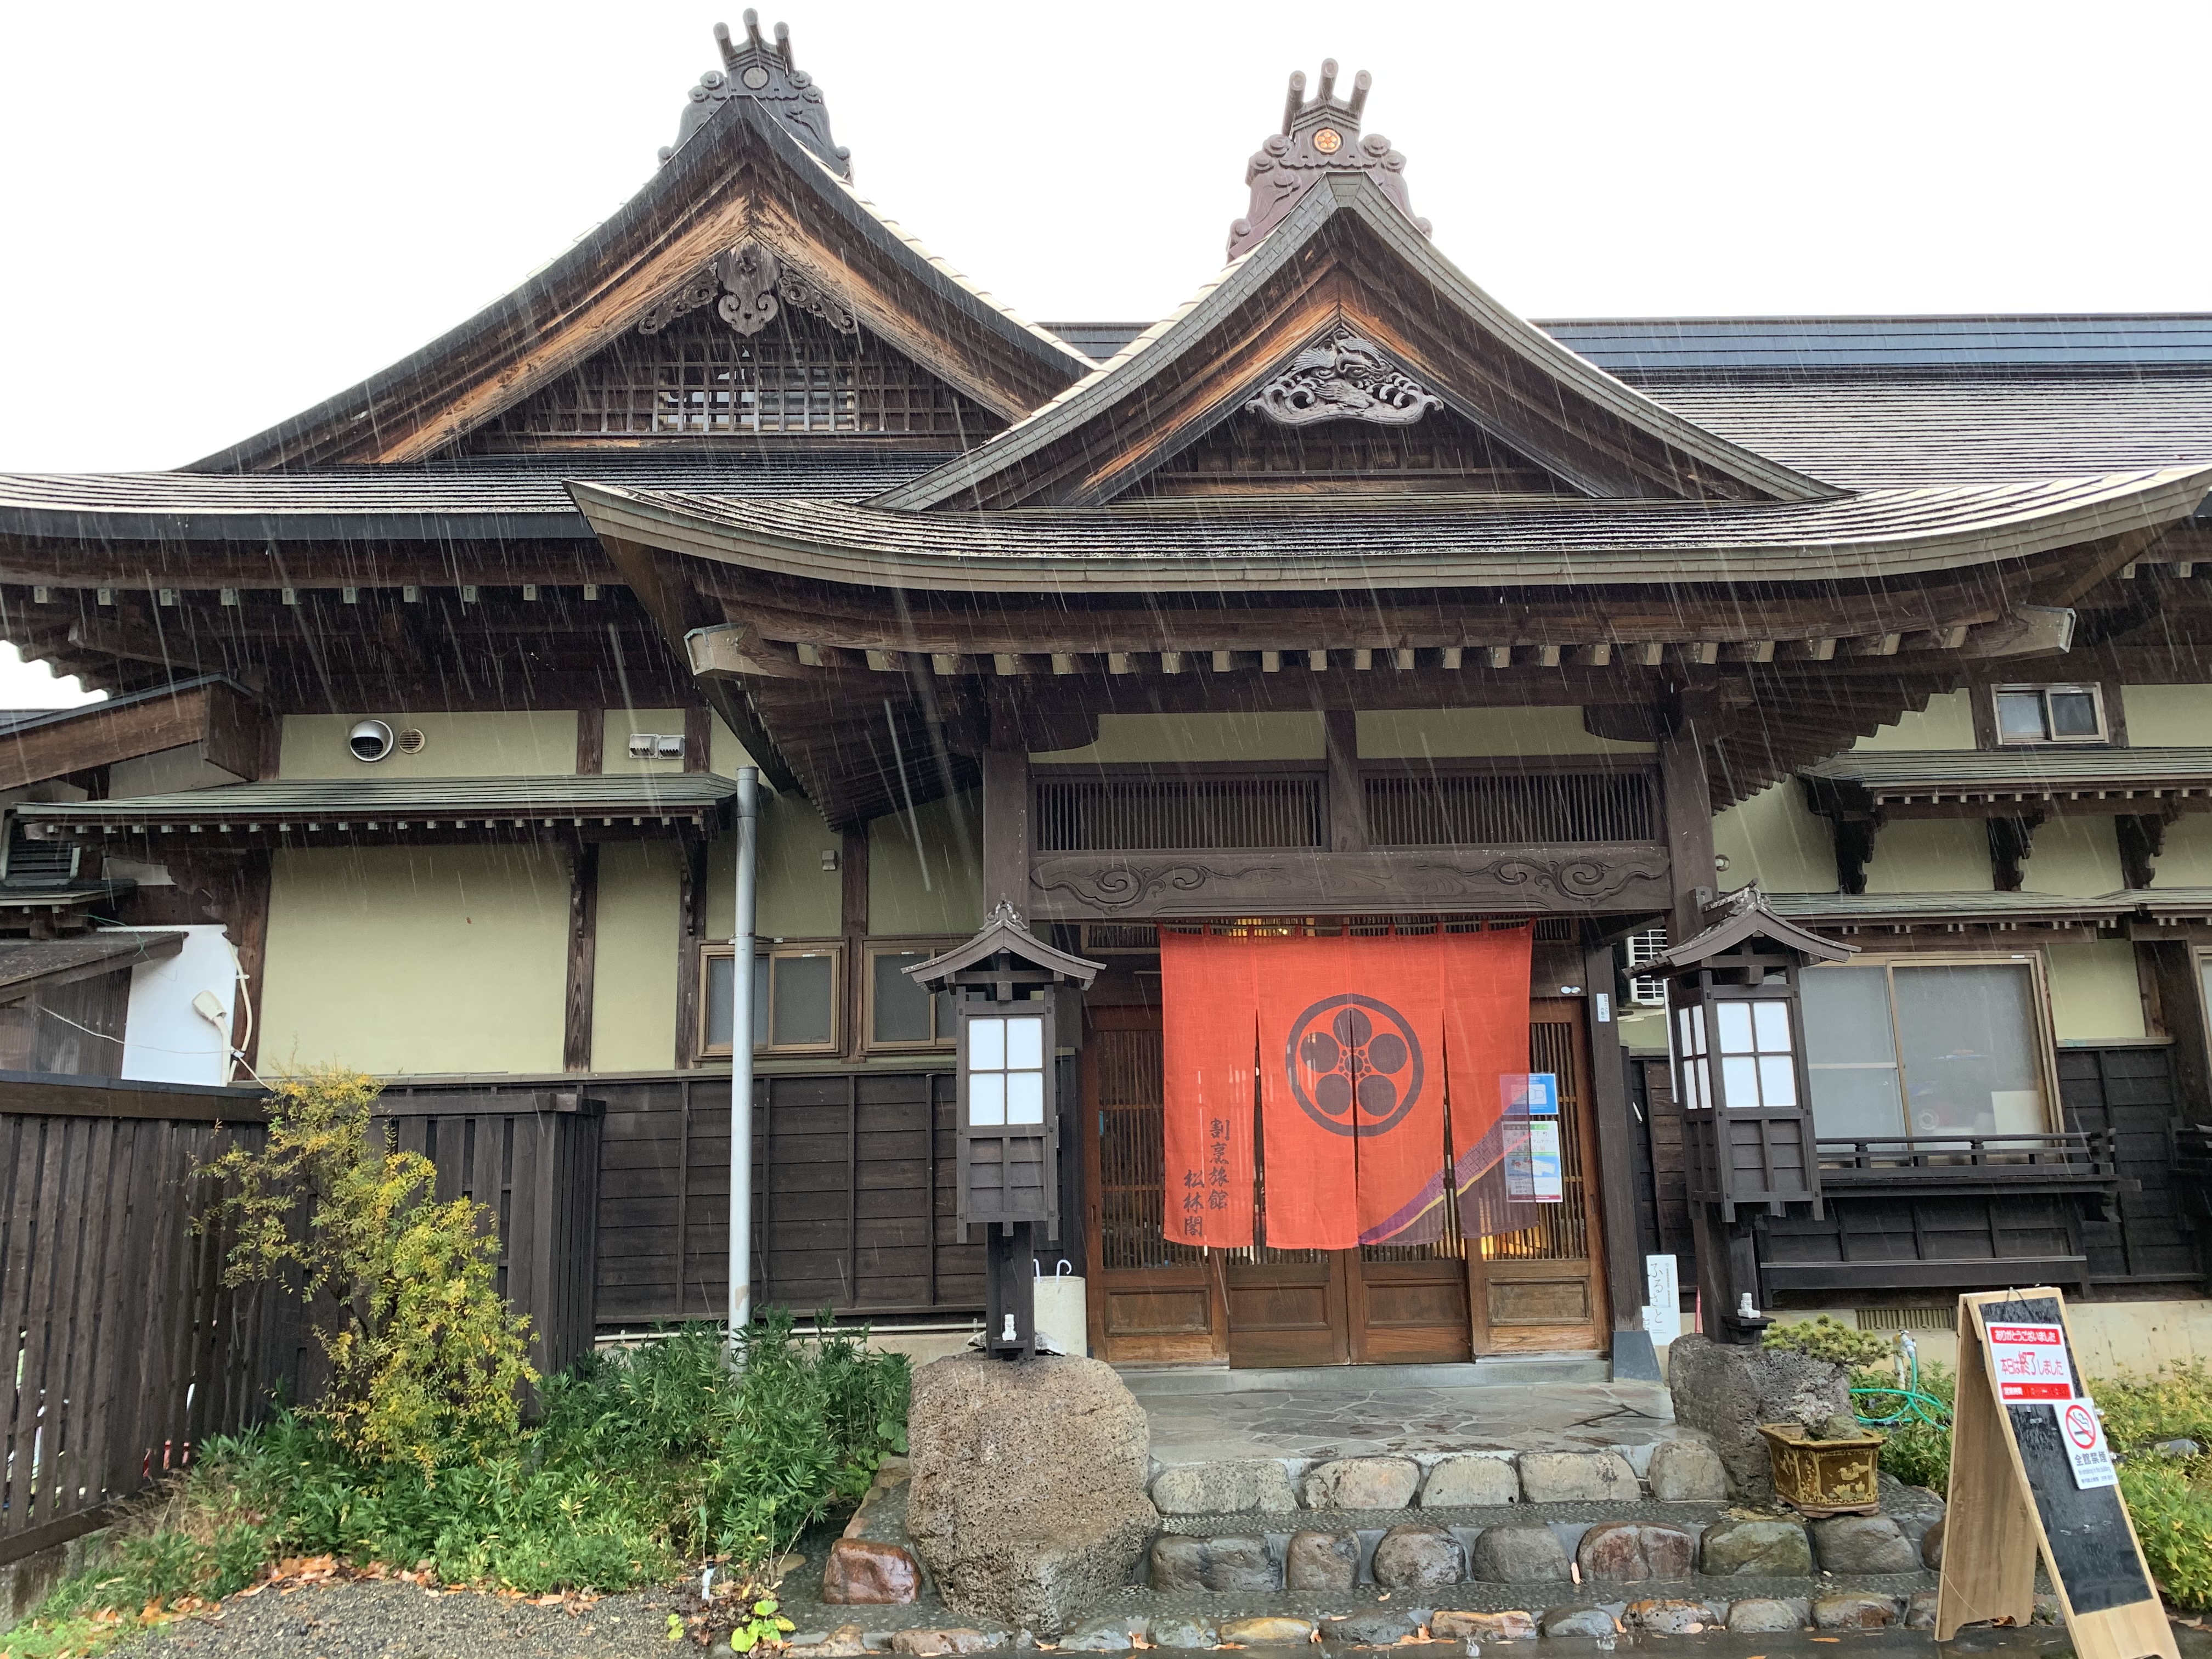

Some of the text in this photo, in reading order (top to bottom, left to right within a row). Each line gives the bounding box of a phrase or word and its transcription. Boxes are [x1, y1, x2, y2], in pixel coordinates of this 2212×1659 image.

[1208, 1118, 1230, 1211] 割烹旅館
[1183, 1169, 1205, 1238] 松林閣
[1995, 1329, 2056, 1342] ありがとうございました
[2000, 1351, 2064, 1376] 本日は終了しました
[2074, 1451, 2108, 1466] 全館禁煙
